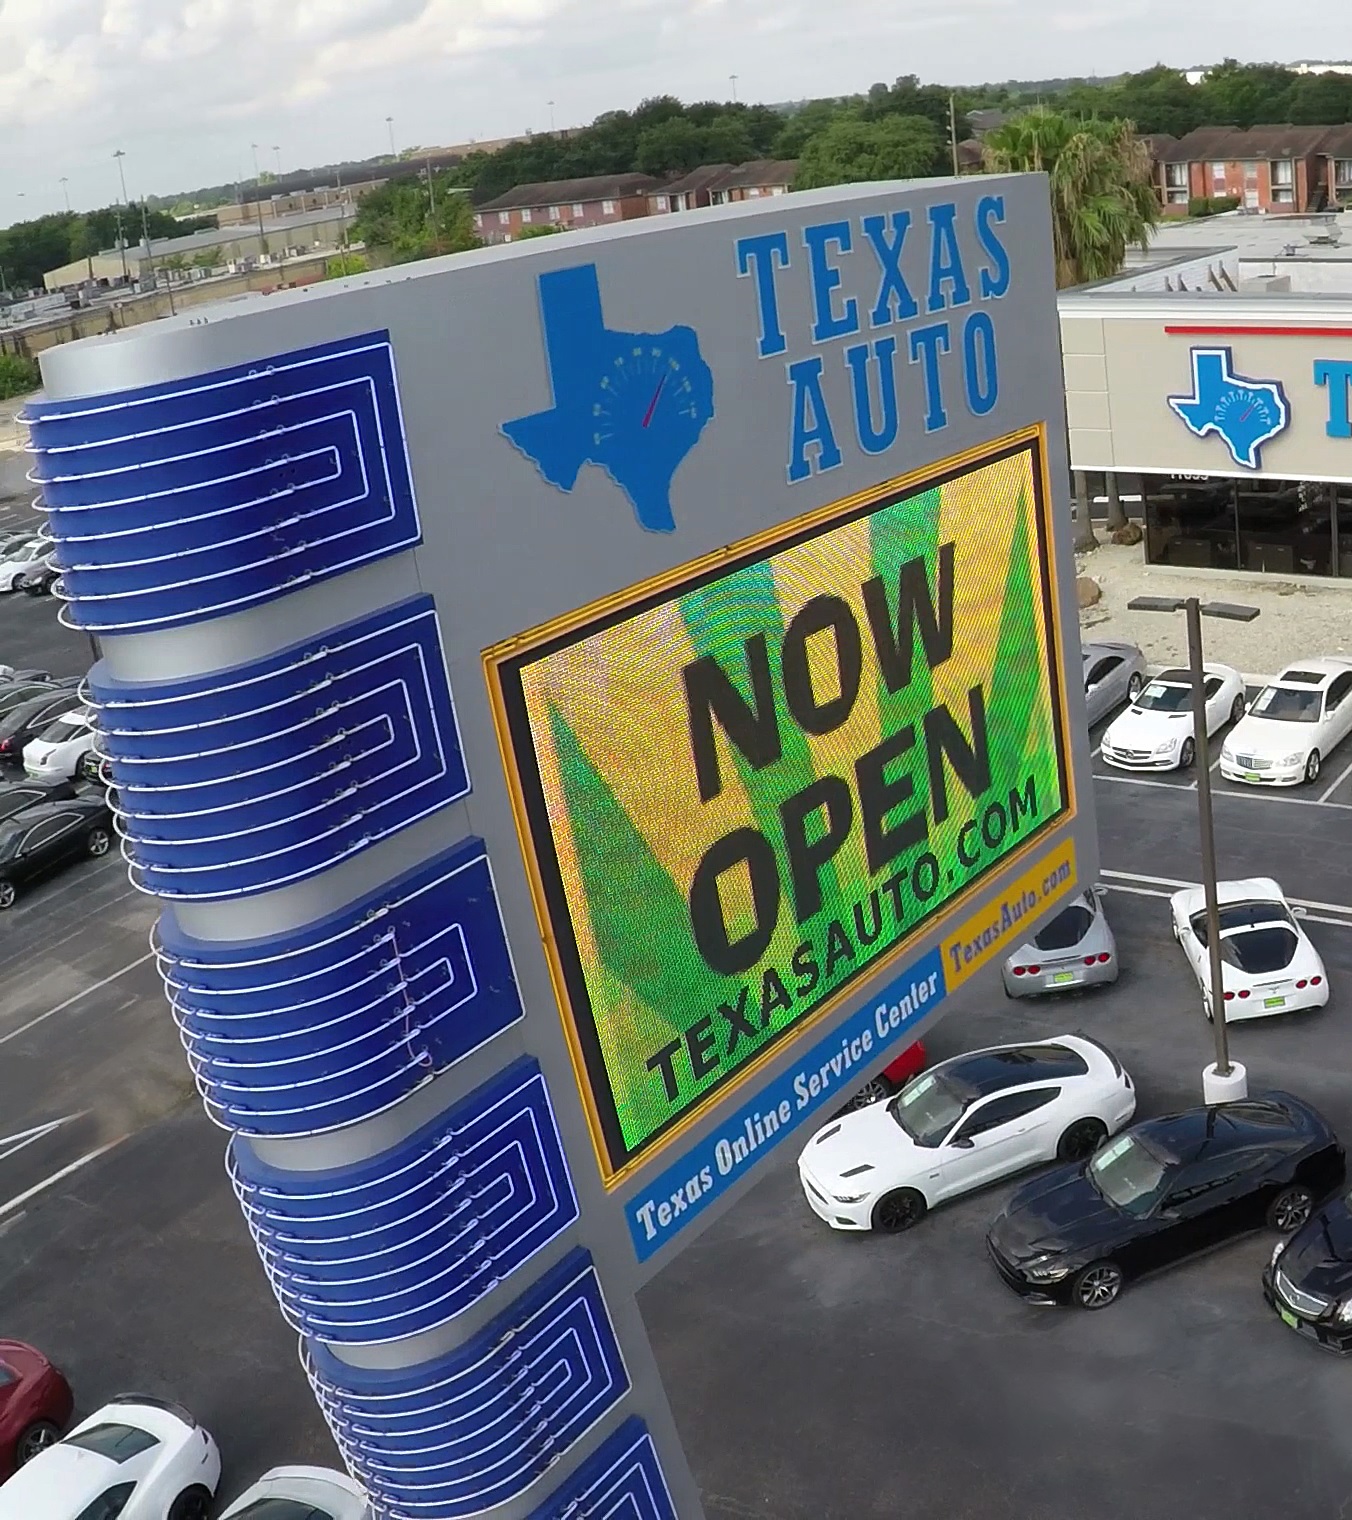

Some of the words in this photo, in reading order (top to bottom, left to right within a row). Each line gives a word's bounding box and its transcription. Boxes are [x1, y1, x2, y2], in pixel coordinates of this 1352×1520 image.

[734, 195, 1012, 359] TEXAS
[785, 310, 998, 484] AUTO
[683, 541, 955, 801] NOW
[646, 776, 1038, 1102] TEXASAUTO.COM
[689, 684, 992, 976] OPEN
[949, 858, 1072, 975] TexasAuto.com
[636, 1162, 713, 1242] Texas
[714, 1100, 791, 1176] Online
[793, 1032, 873, 1111] Service
[875, 970, 938, 1040] Center
